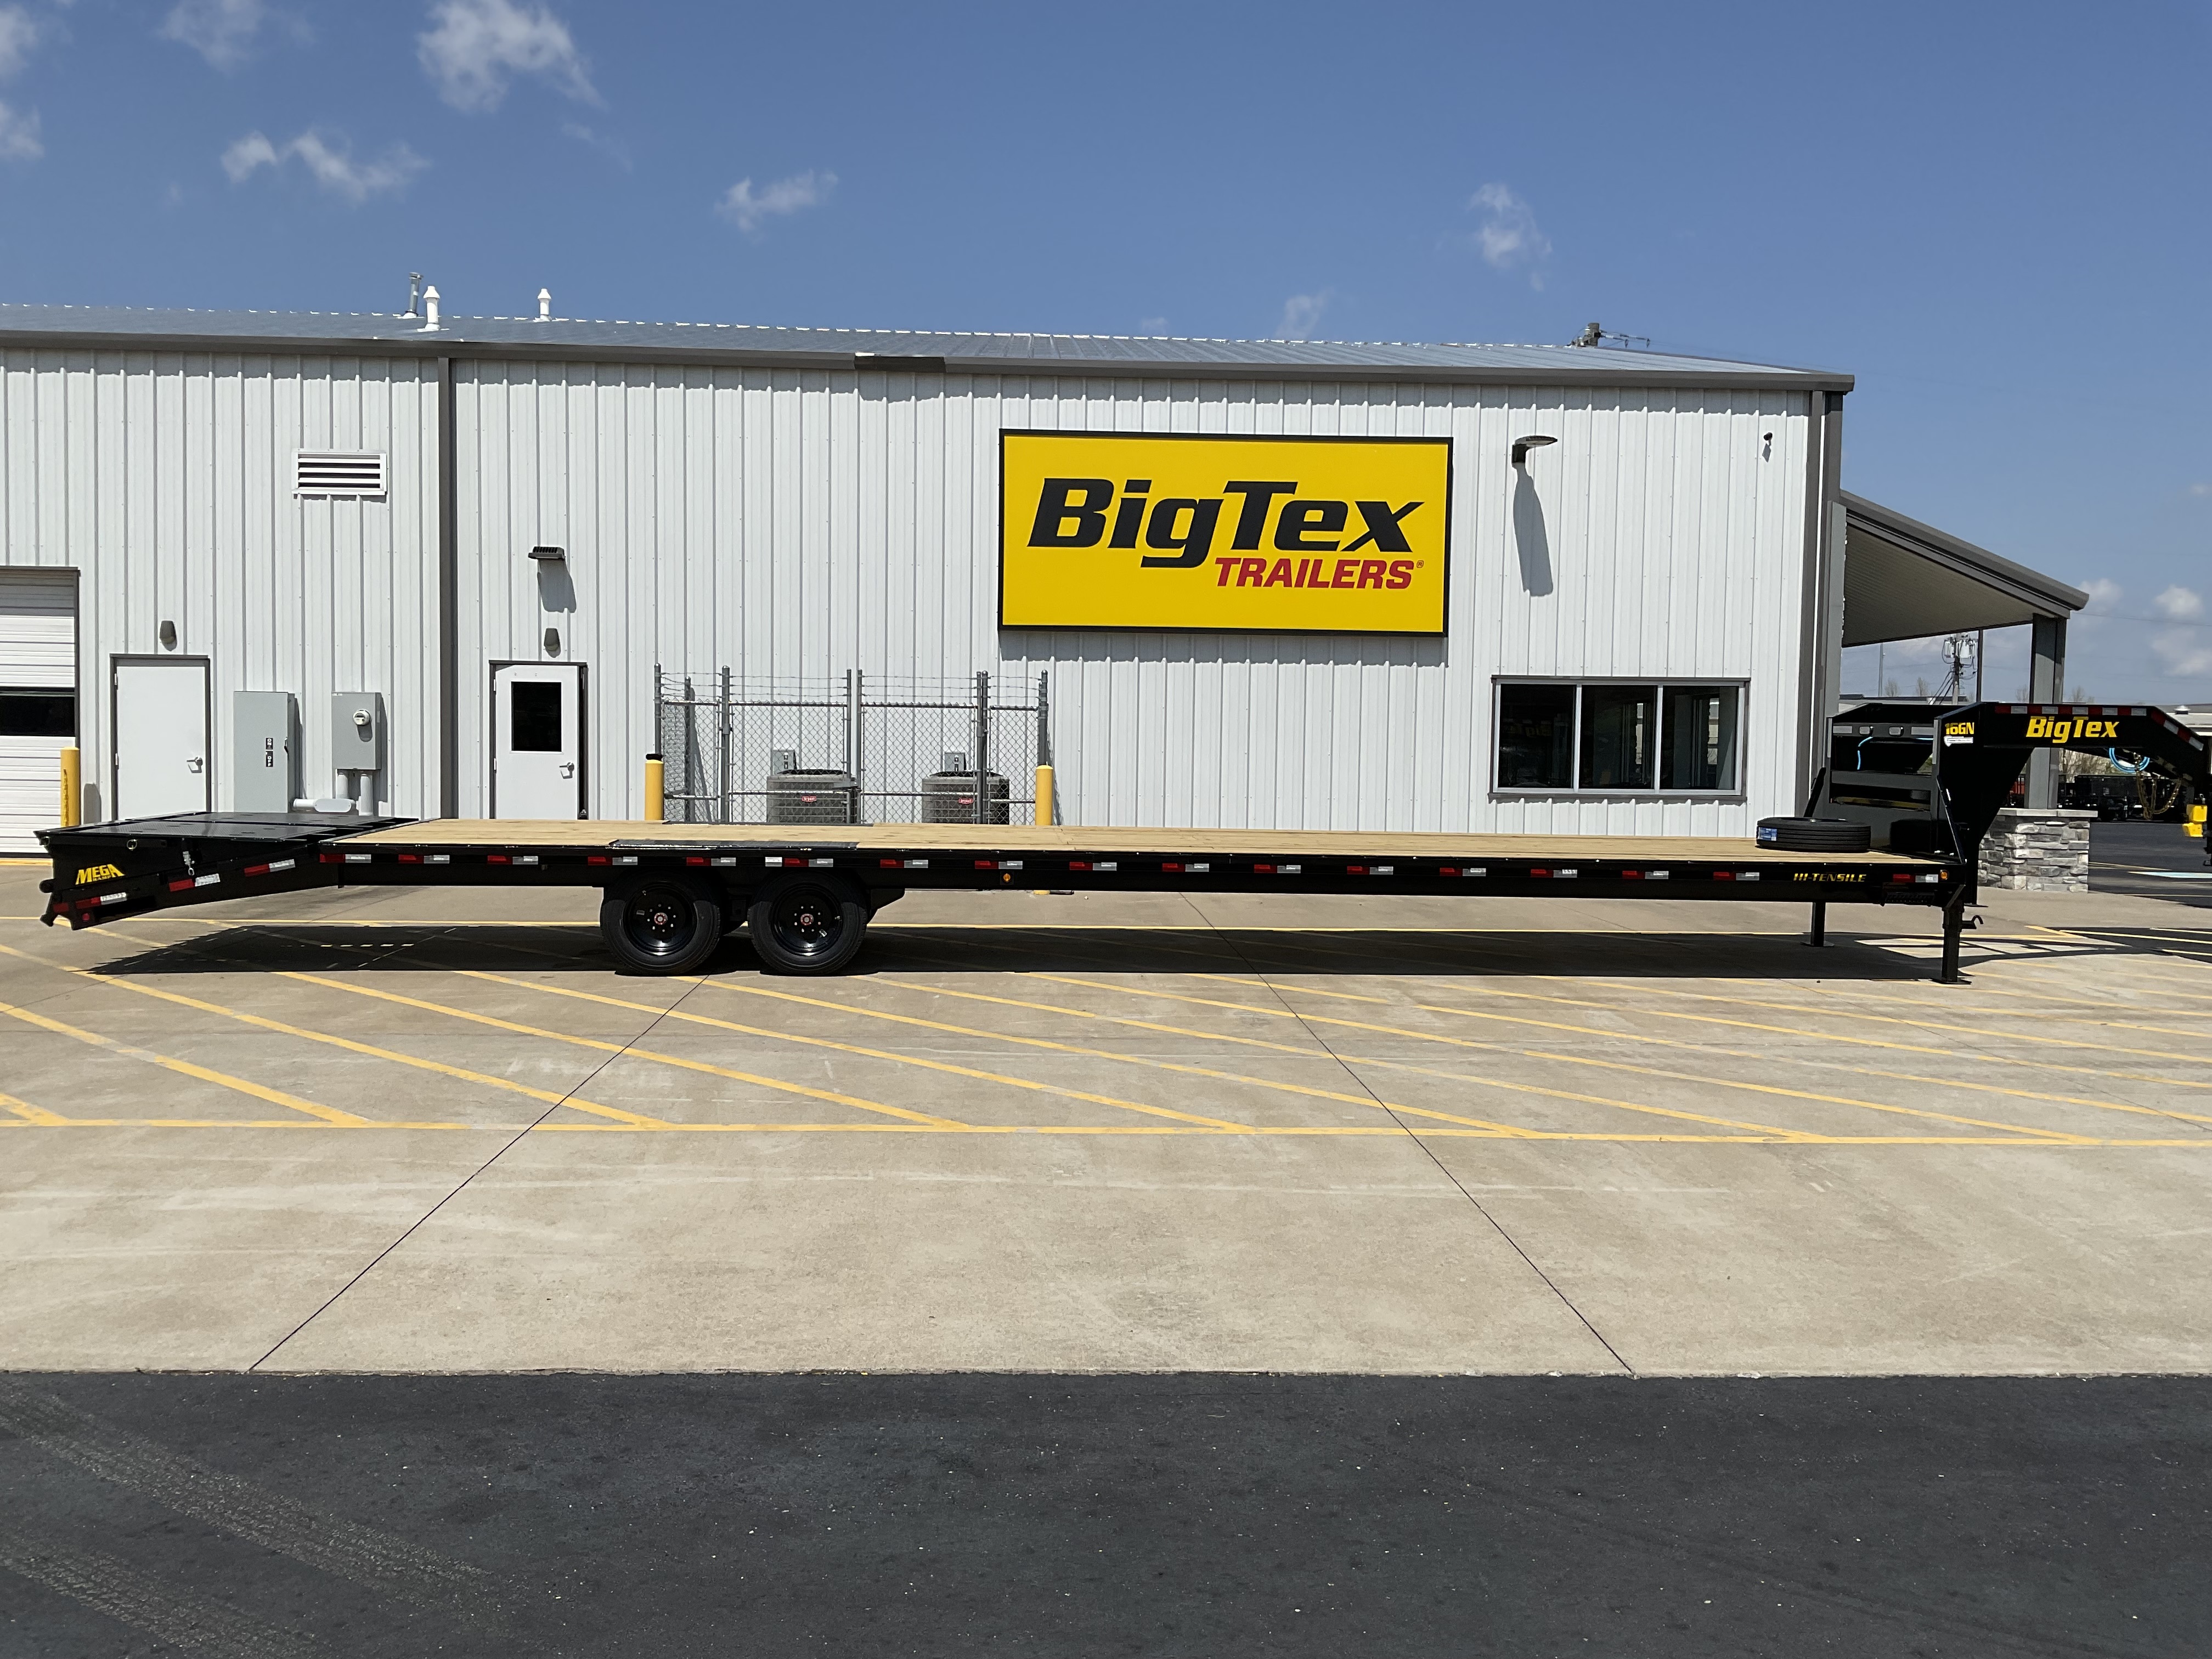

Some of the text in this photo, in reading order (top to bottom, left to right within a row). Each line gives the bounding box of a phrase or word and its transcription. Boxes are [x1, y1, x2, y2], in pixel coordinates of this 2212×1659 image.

[1026, 478, 1425, 568] BigTex
[1944, 721, 1975, 735] 16GN
[2025, 715, 2120, 744] BigTex
[75, 864, 126, 885] MEGA
[1793, 873, 1867, 882] HI-TENSILE
